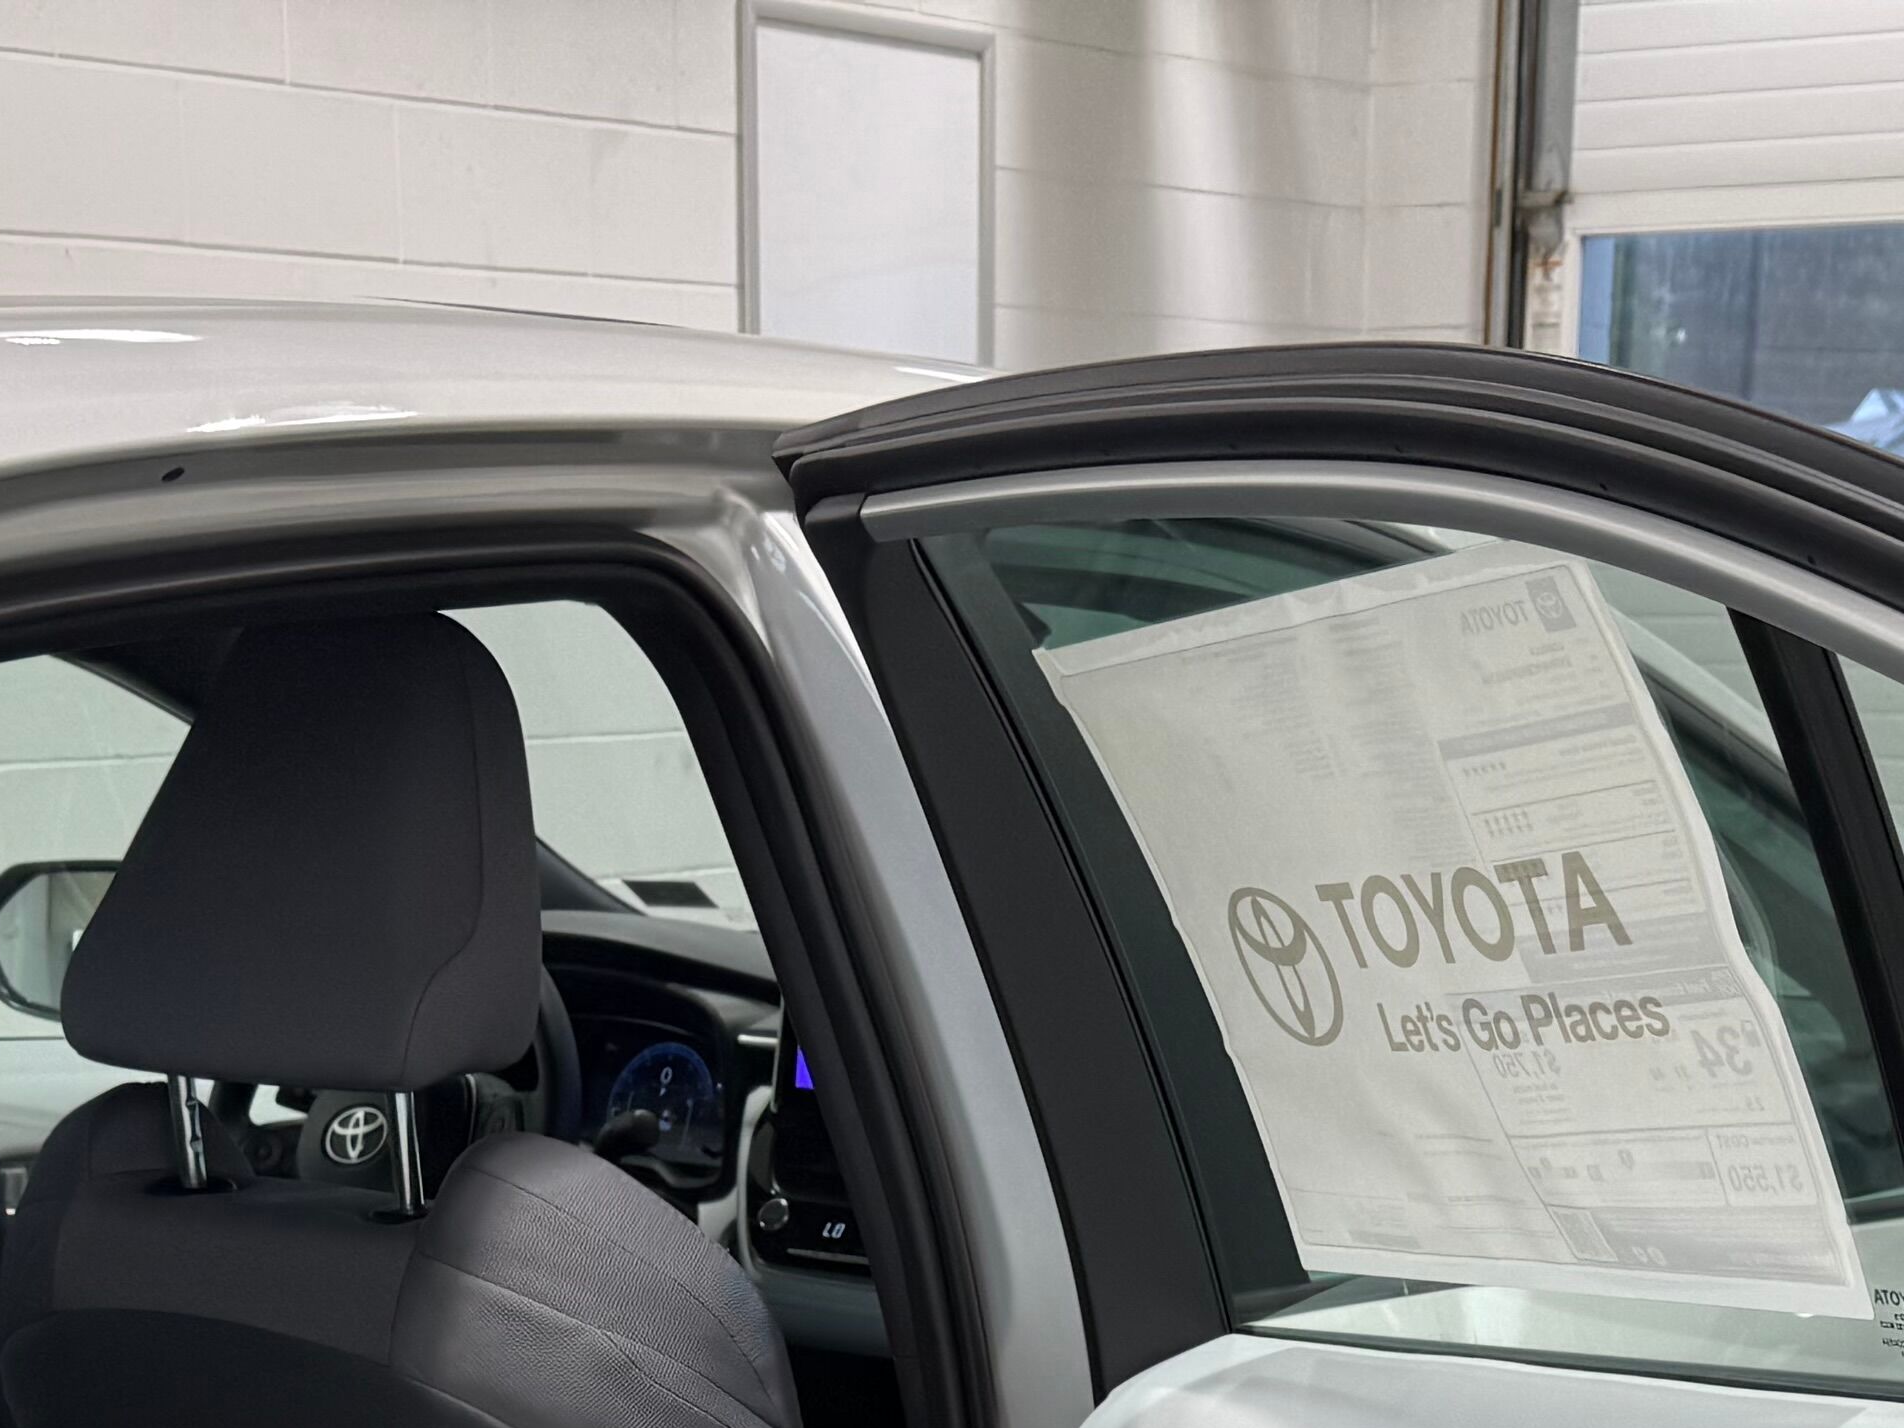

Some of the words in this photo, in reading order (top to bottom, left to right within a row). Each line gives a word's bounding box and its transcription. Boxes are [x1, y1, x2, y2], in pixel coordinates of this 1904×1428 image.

[1315, 851, 1634, 969] TOYOTA
[1376, 1000, 1462, 1053] Let's
[1461, 998, 1521, 1052] Go
[1519, 991, 1671, 1047] Places
[822, 1221, 846, 1239] LO
